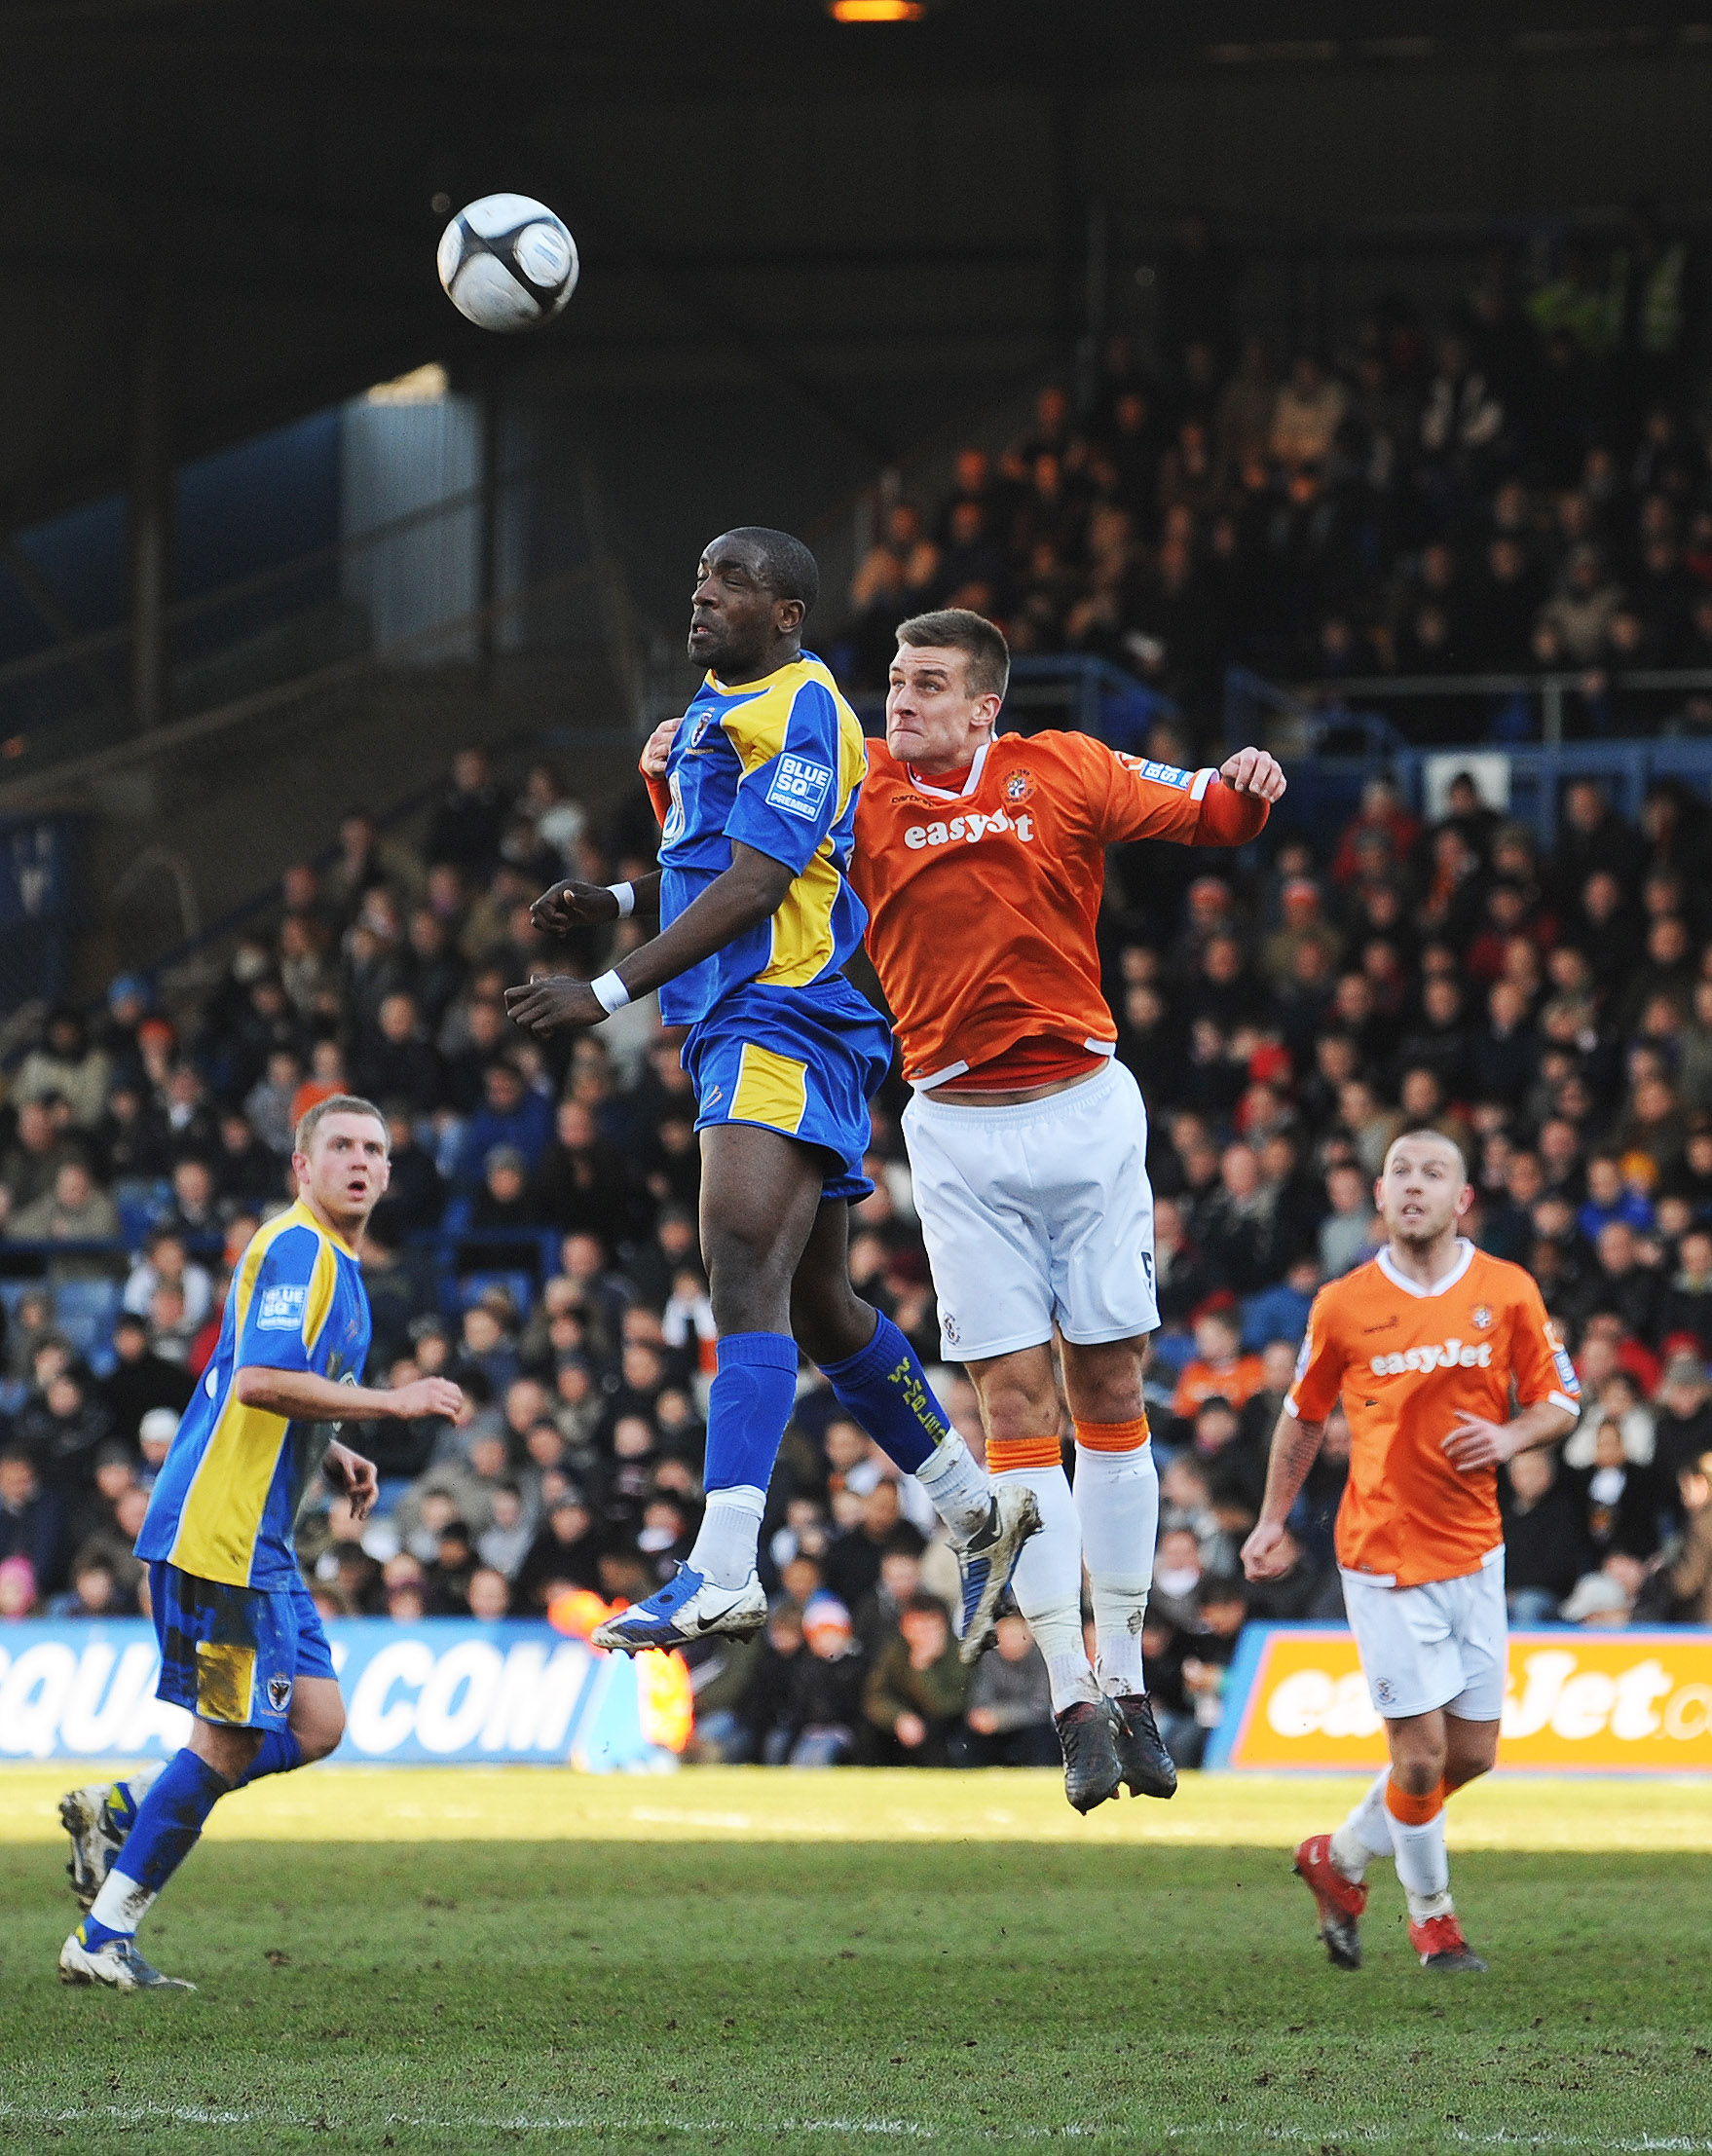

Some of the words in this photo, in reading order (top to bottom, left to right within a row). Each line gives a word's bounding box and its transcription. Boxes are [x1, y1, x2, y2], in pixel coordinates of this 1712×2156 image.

[776, 773, 807, 797] SQ
[782, 759, 829, 787] BLUE
[770, 792, 816, 817] PREMIER
[904, 808, 1034, 849] easyJt
[1369, 1338, 1493, 1377] easyJet
